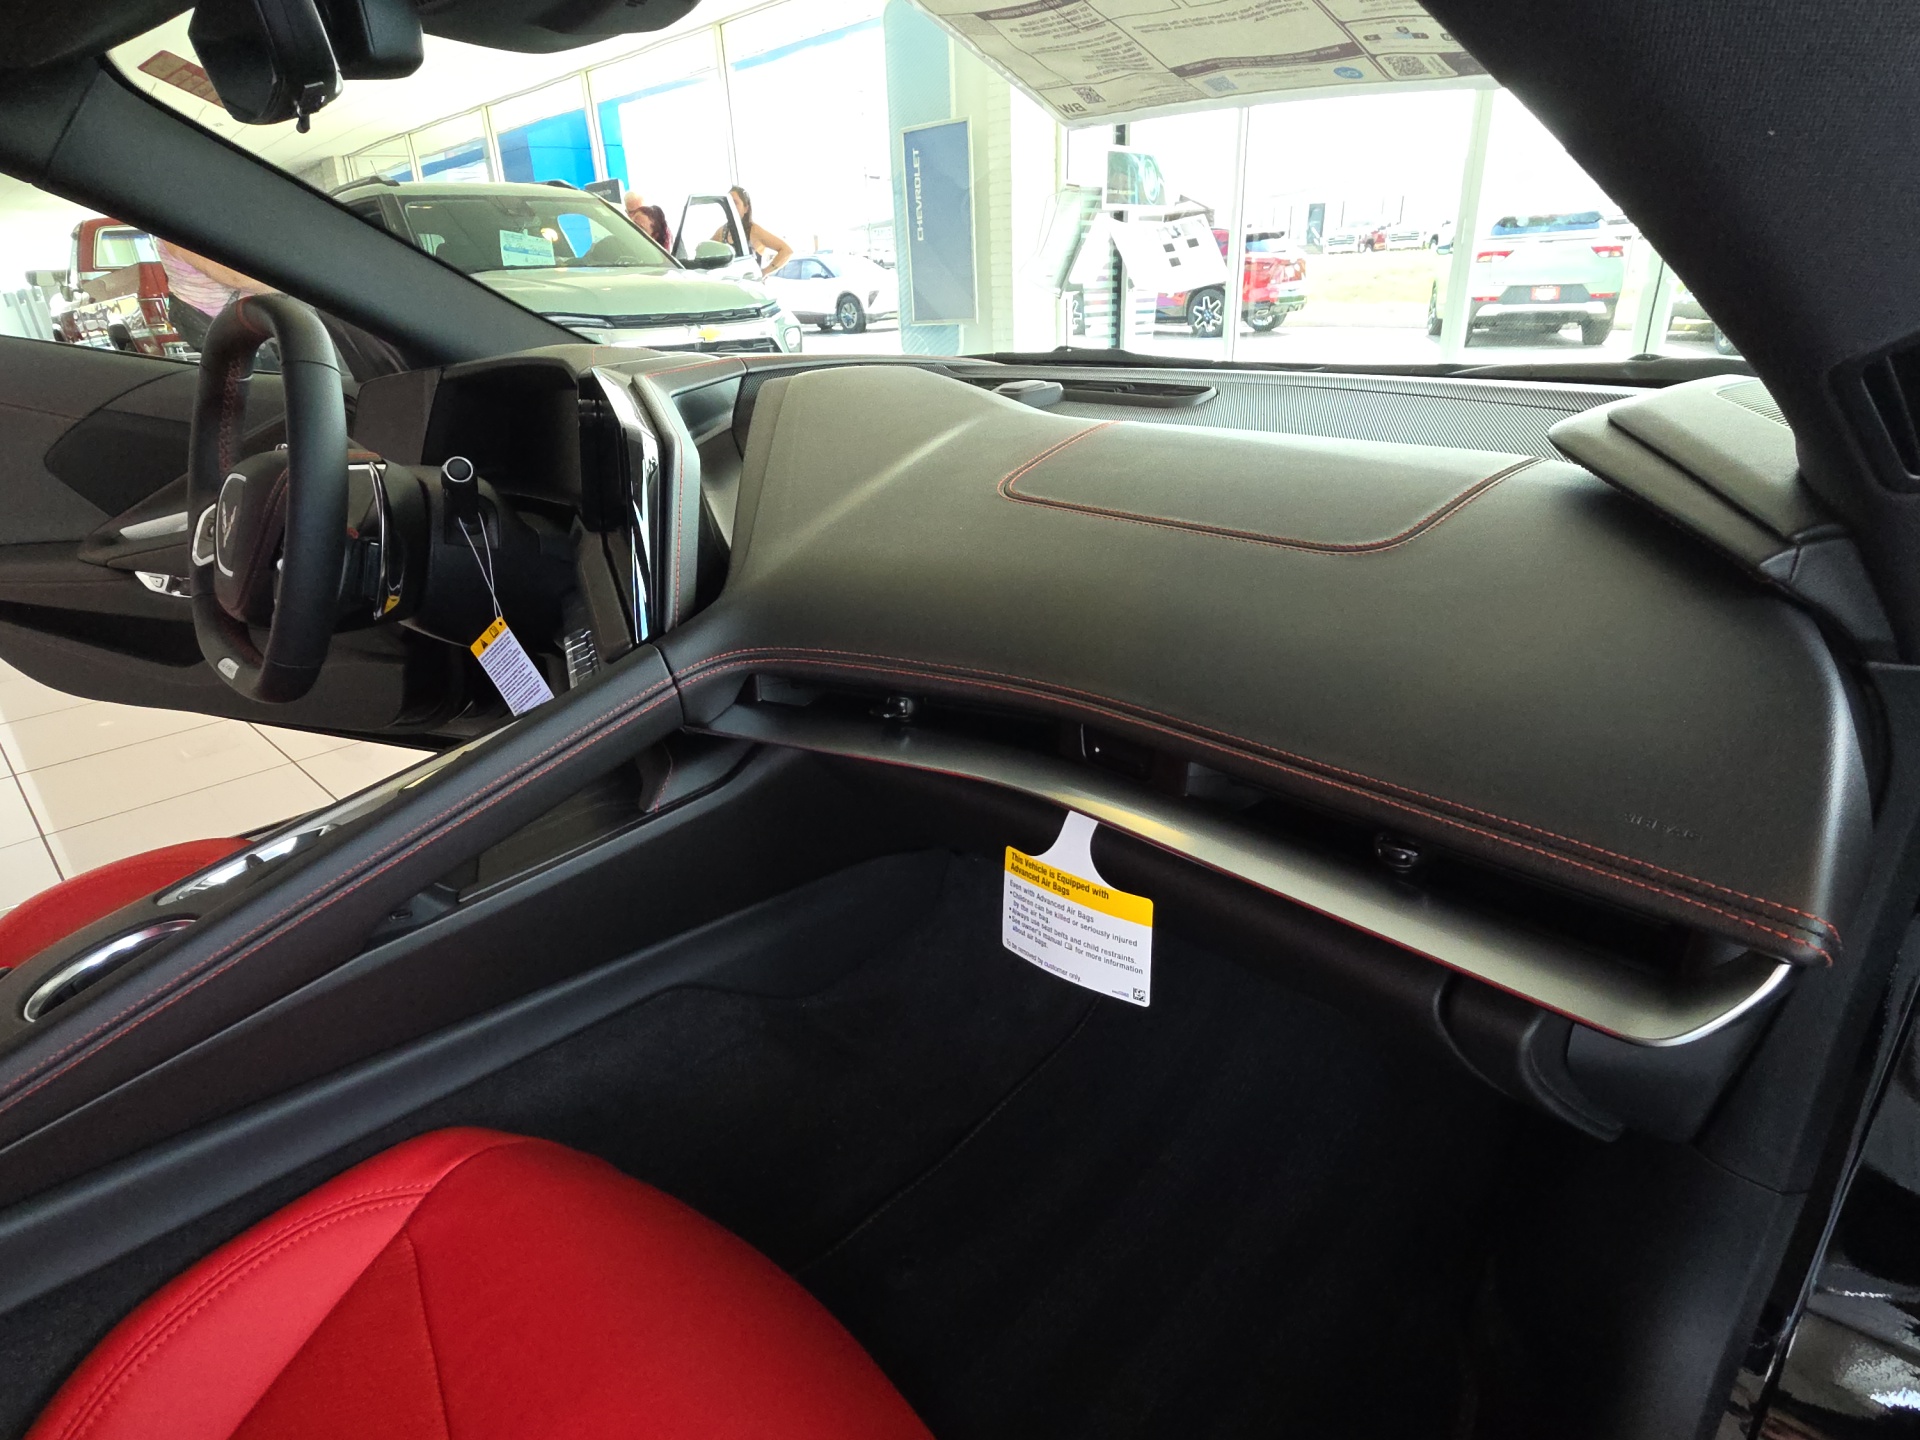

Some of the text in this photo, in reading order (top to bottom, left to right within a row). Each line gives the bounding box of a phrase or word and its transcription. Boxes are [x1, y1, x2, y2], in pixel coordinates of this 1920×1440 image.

[912, 148, 924, 240] CHEVROLET
[1011, 862, 1070, 896] Advanced Air Bags
[1012, 852, 1109, 900] This Vehicle is Equipped with
[1010, 880, 1094, 923] Even with Advanced Air Bags
[1014, 900, 1019, 909] by
[1012, 908, 1136, 964] Always use seat belts and child restraints.
[1012, 925, 1026, 936] about
[1035, 936, 1048, 948] bags.
[1012, 916, 1020, 925] See
[1042, 932, 1062, 946] manual
[1075, 946, 1084, 954] for
[1086, 951, 1102, 962] more
[1104, 957, 1143, 974] information
[1034, 903, 1044, 912] can
[1046, 907, 1052, 916] be
[1054, 912, 1070, 924] killed
[1080, 923, 1110, 940] seriously
[1112, 934, 1138, 947] injured
[1038, 956, 1043, 965] by
[1044, 961, 1068, 976] customer
